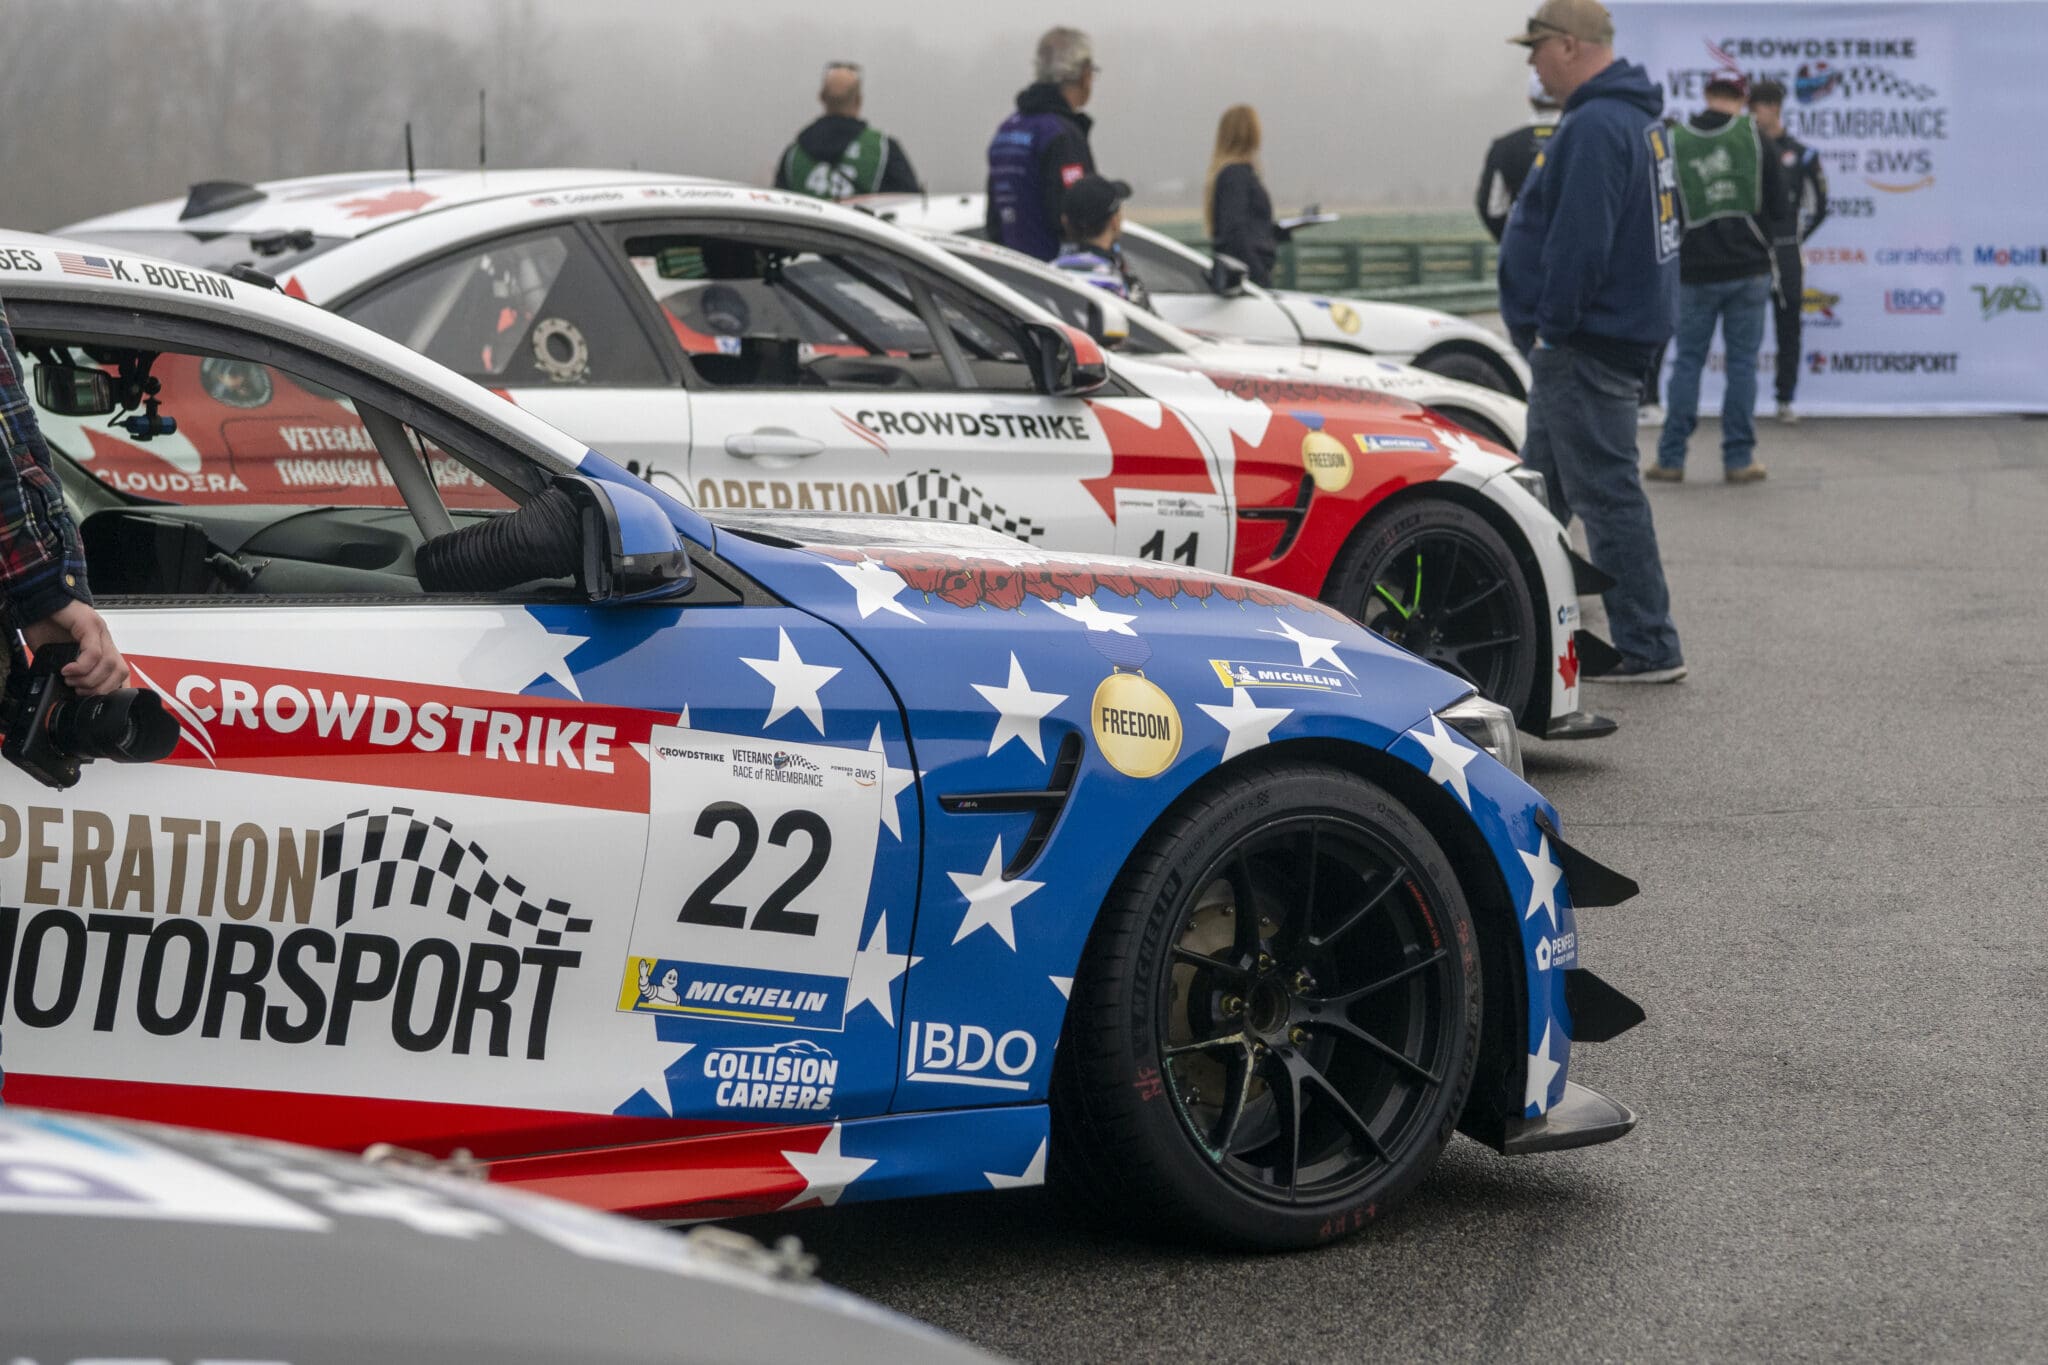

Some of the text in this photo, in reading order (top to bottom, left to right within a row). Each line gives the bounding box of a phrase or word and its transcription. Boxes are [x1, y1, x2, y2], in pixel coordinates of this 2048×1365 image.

[1721, 38, 1917, 59] CROWDSTRIKE
[1783, 108, 1947, 139] EMEMBRANCE
[1866, 150, 1933, 173] aws
[109, 259, 235, 300] K. BOEHM
[1893, 288, 1945, 309] BDO
[1831, 353, 1959, 374] MOTORSPORT
[857, 409, 1090, 441] CROWDSTRIKE
[279, 427, 376, 451] VETERA
[275, 460, 377, 487] THROUGH
[1309, 453, 1346, 469] FREEDOM
[1258, 670, 1342, 688] MICHELIN
[174, 675, 616, 775] CROWDSTRIKE
[1102, 707, 1171, 742] FREEDOM
[659, 747, 725, 763] CROWDSTRIKE
[732, 749, 773, 766] VETERANS
[732, 765, 824, 787] RACE of REMEMBRANCE
[855, 768, 876, 780] aws
[676, 801, 833, 937] 22
[685, 980, 828, 1013] MICHELIN
[924, 1023, 1037, 1076] BDO
[703, 1051, 838, 1086] COLLISION
[716, 1078, 832, 1110] CAREERS
